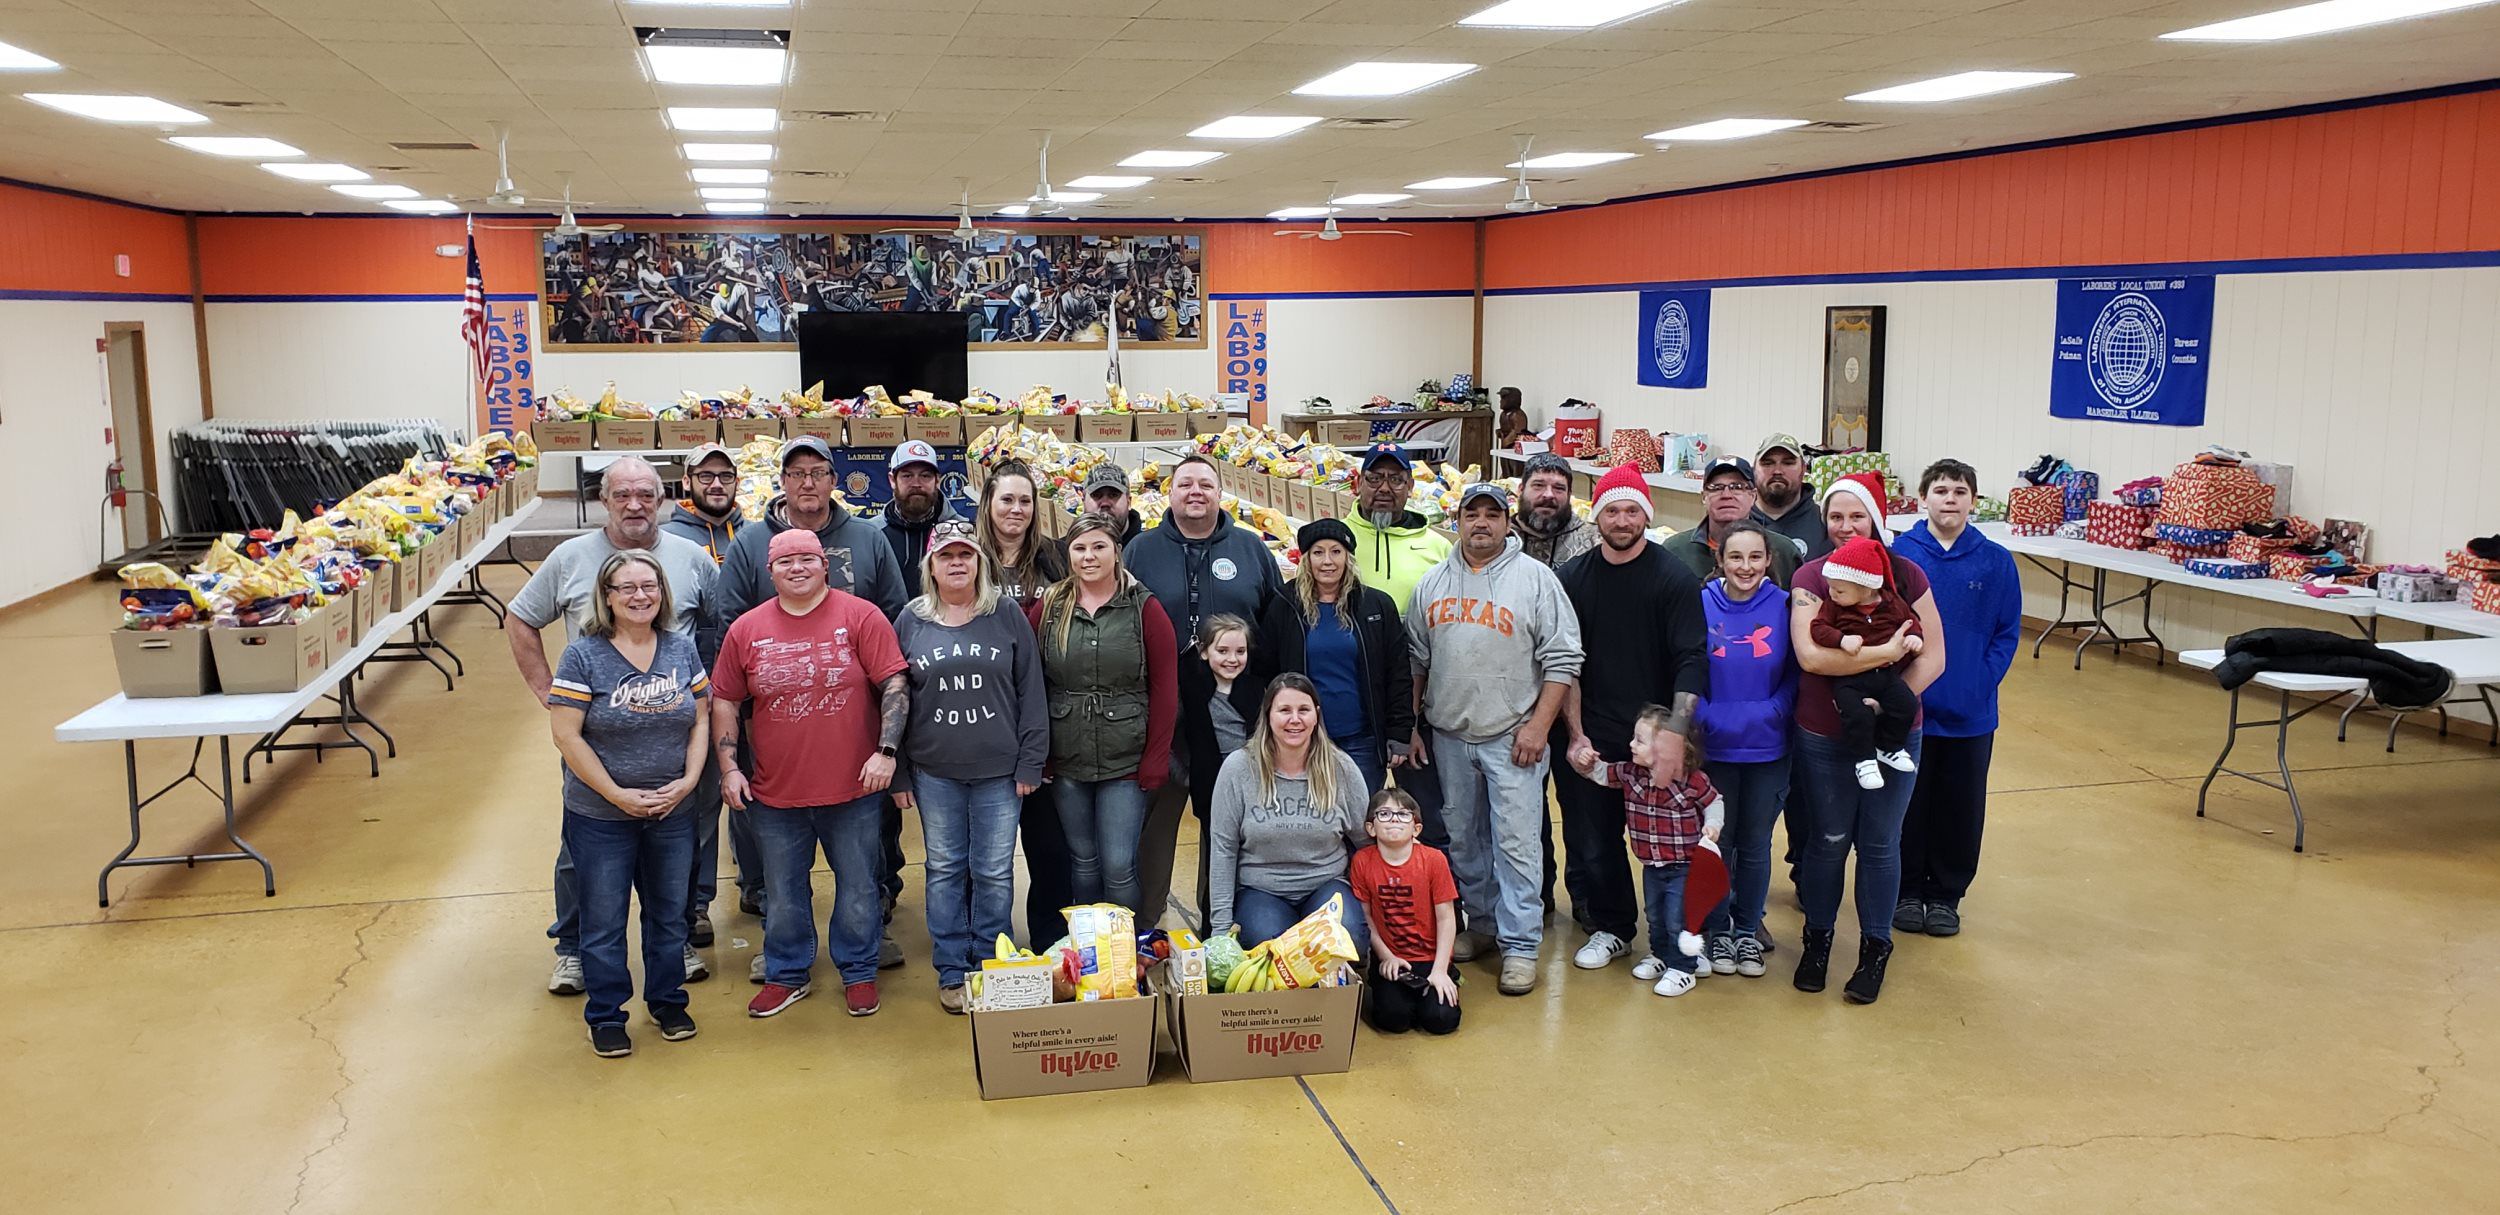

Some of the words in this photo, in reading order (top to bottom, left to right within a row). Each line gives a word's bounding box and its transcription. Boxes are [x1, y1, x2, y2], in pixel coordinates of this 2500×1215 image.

[2120, 281, 2143, 291] LOCAL
[2144, 280, 2167, 290] UNION
[2157, 332, 2166, 370] UNION
[2097, 378, 2106, 389] of
[2104, 389, 2122, 404] North
[2123, 381, 2156, 405] America
[1426, 598, 1515, 637] TEXAS
[916, 643, 1001, 671] HEART
[608, 667, 680, 709] Original
[938, 673, 983, 692] AND
[934, 705, 996, 725] SOUL
[1221, 1009, 1247, 1018] Where
[1248, 1007, 1273, 1016] there's
[1221, 1019, 1248, 1028] helpful
[1249, 1018, 1270, 1027] smile
[1271, 1018, 1280, 1026] in
[1281, 1017, 1302, 1026] every
[1302, 1014, 1323, 1023] aisle!
[1012, 1030, 1038, 1039] Where
[1039, 1027, 1065, 1037] there's
[1012, 1039, 1041, 1050] helpful
[1042, 1038, 1064, 1047] smile
[1064, 1037, 1073, 1045] in
[1074, 1036, 1095, 1046] every
[1097, 1033, 1118, 1042] aisle!
[1247, 1032, 1323, 1058] HyVee
[1041, 1050, 1119, 1077] HyVee
